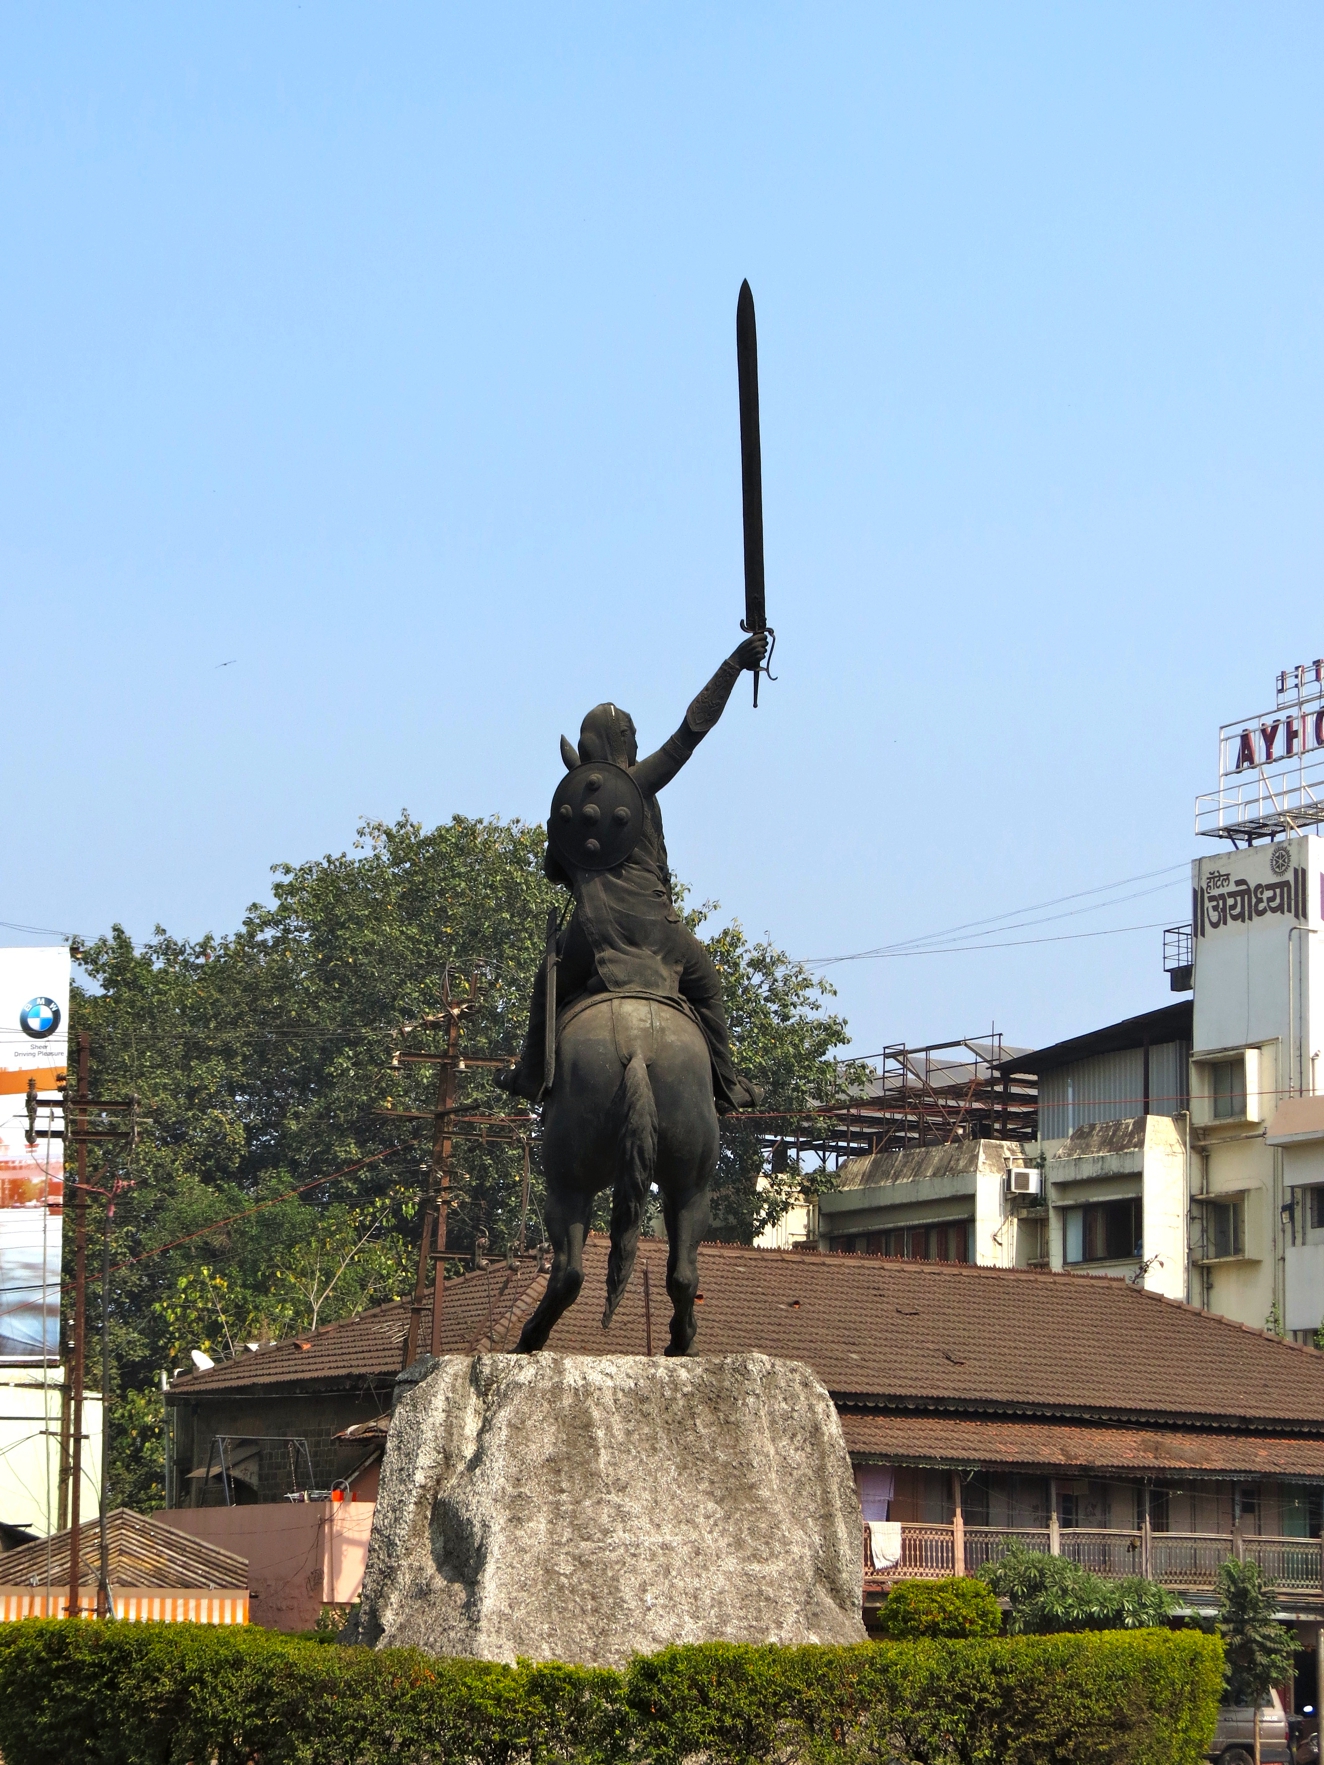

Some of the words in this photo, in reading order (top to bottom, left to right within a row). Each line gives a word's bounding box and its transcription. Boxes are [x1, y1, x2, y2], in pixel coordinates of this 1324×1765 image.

[1205, 870, 1231, 894] हॉटेल
[1206, 878, 1292, 930] अयोध्या
[24, 997, 59, 1012] BMW
